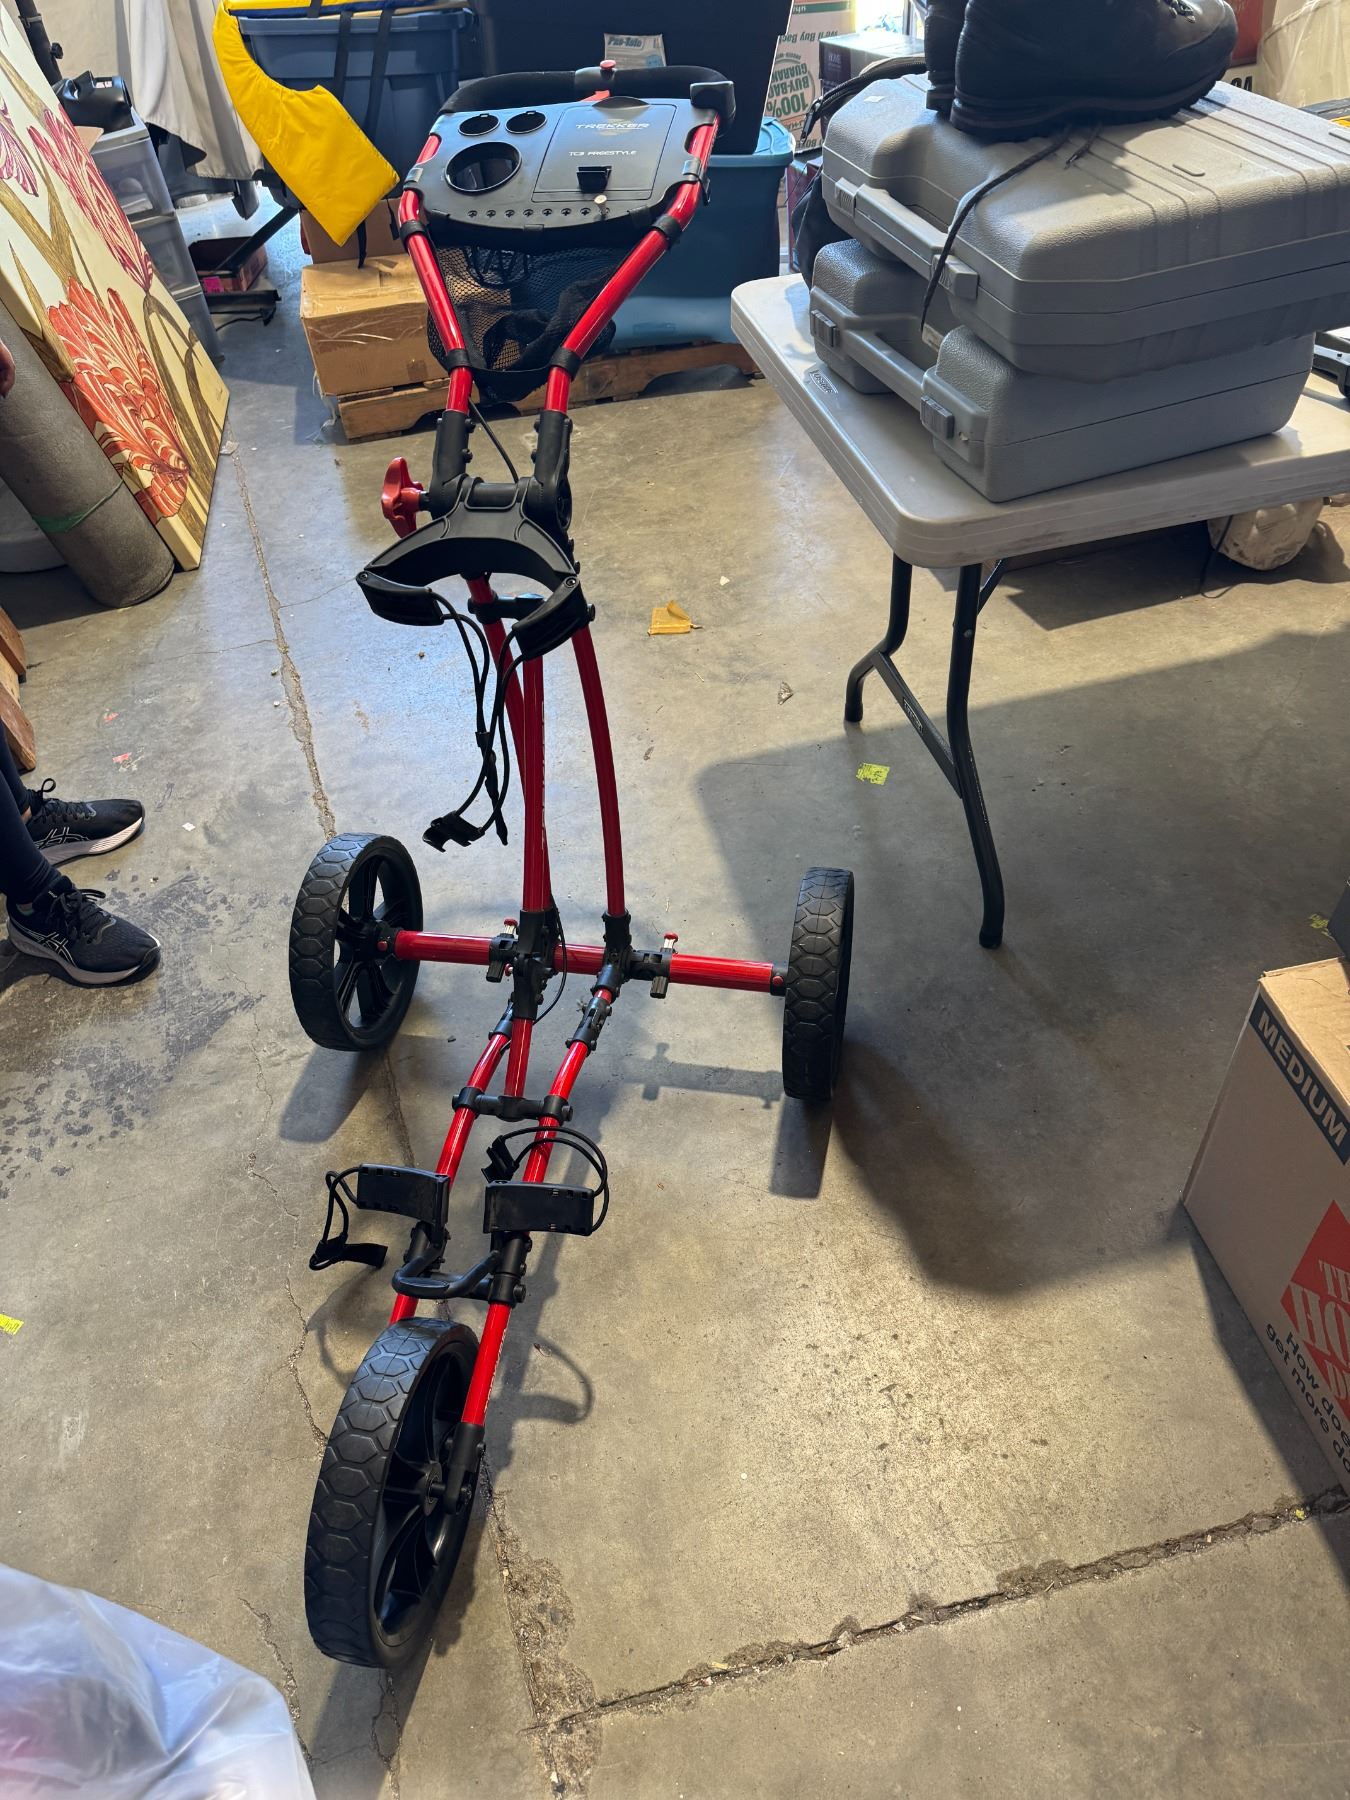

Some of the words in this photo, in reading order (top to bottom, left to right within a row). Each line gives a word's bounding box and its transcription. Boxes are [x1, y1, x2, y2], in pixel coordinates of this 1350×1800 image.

[800, 31, 815, 42] Buy
[771, 62, 808, 81] GUARAN
[765, 92, 809, 117] 100%
[1258, 1010, 1348, 1147] MEDIUM
[1266, 1324, 1291, 1365] get
[1292, 1367, 1330, 1434] more
[1286, 1332, 1320, 1390] How
